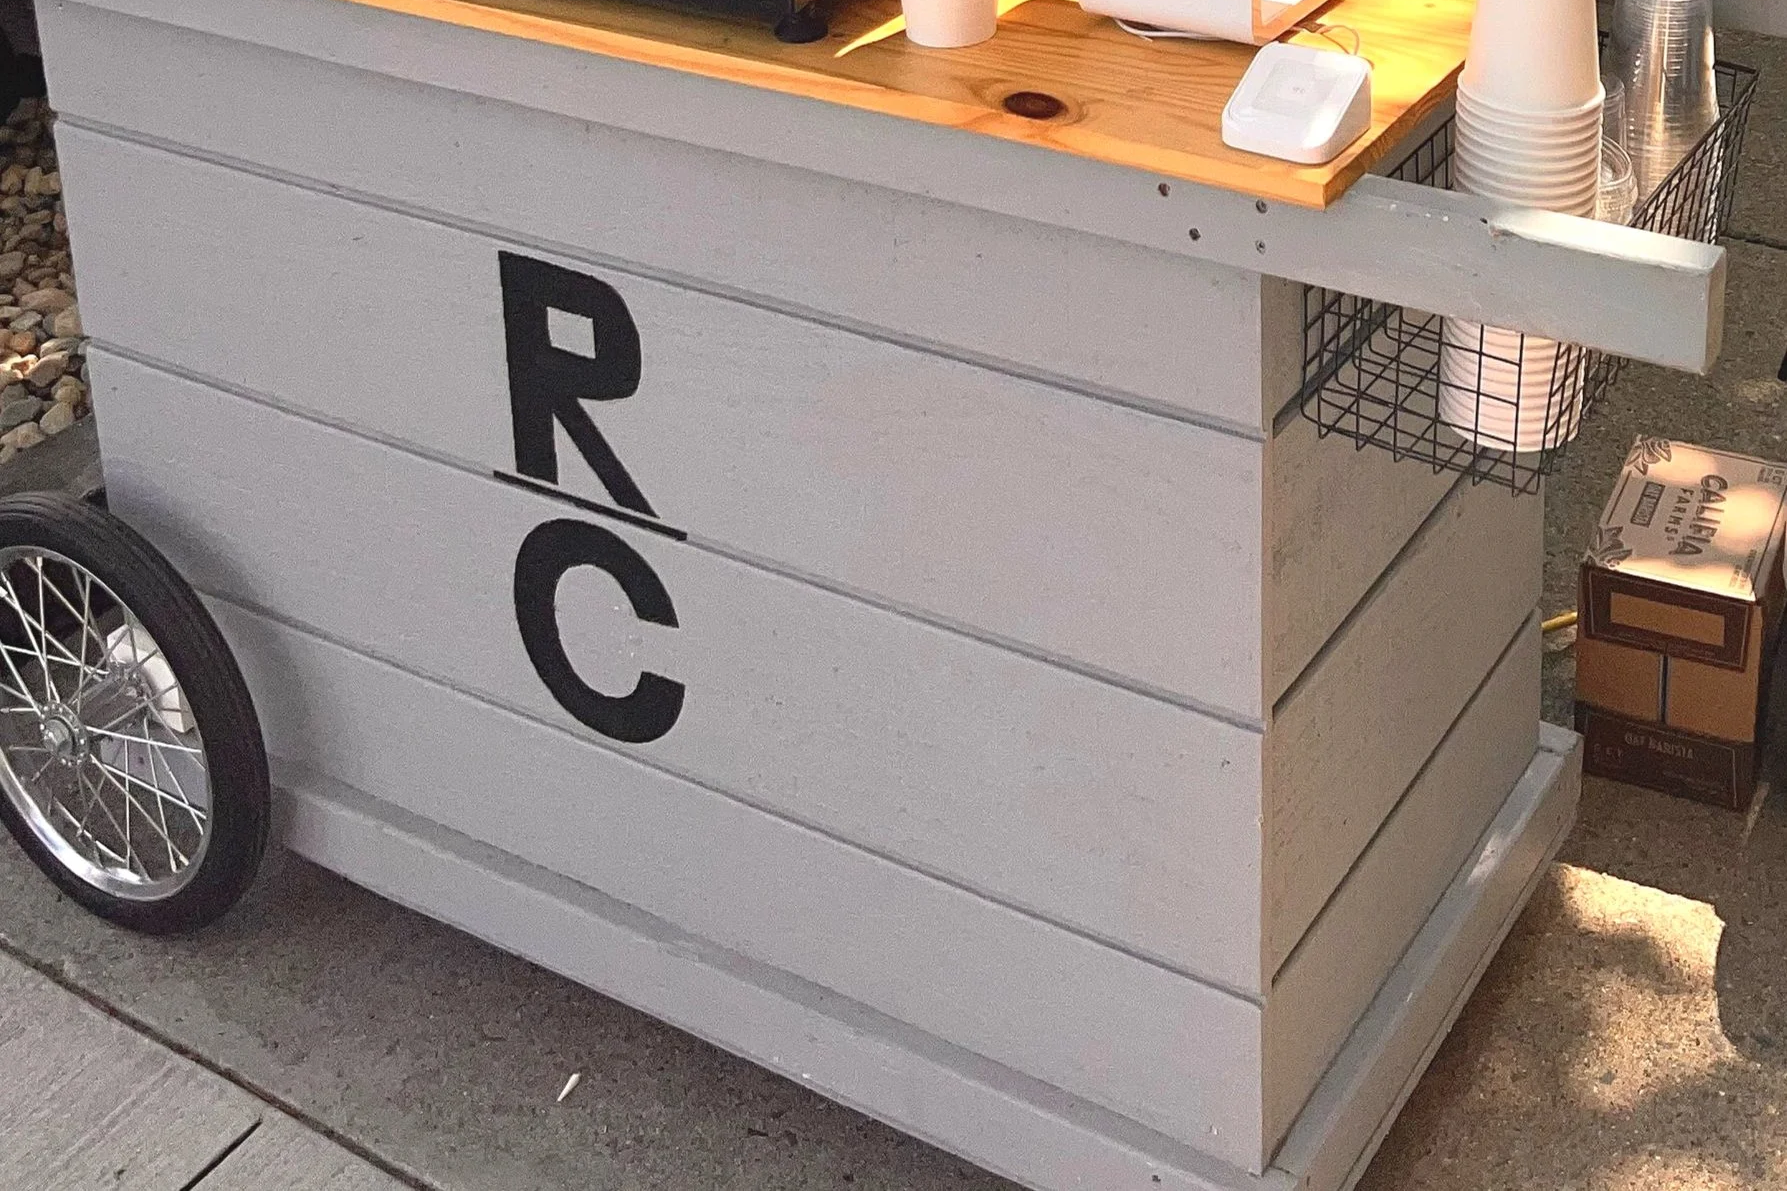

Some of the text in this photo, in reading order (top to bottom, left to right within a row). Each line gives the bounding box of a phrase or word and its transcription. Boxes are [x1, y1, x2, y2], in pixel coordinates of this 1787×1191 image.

[498, 250, 660, 519] R
[1664, 487, 1695, 535] FARMS
[1669, 474, 1728, 556] CALIFIA
[514, 518, 686, 744] C
